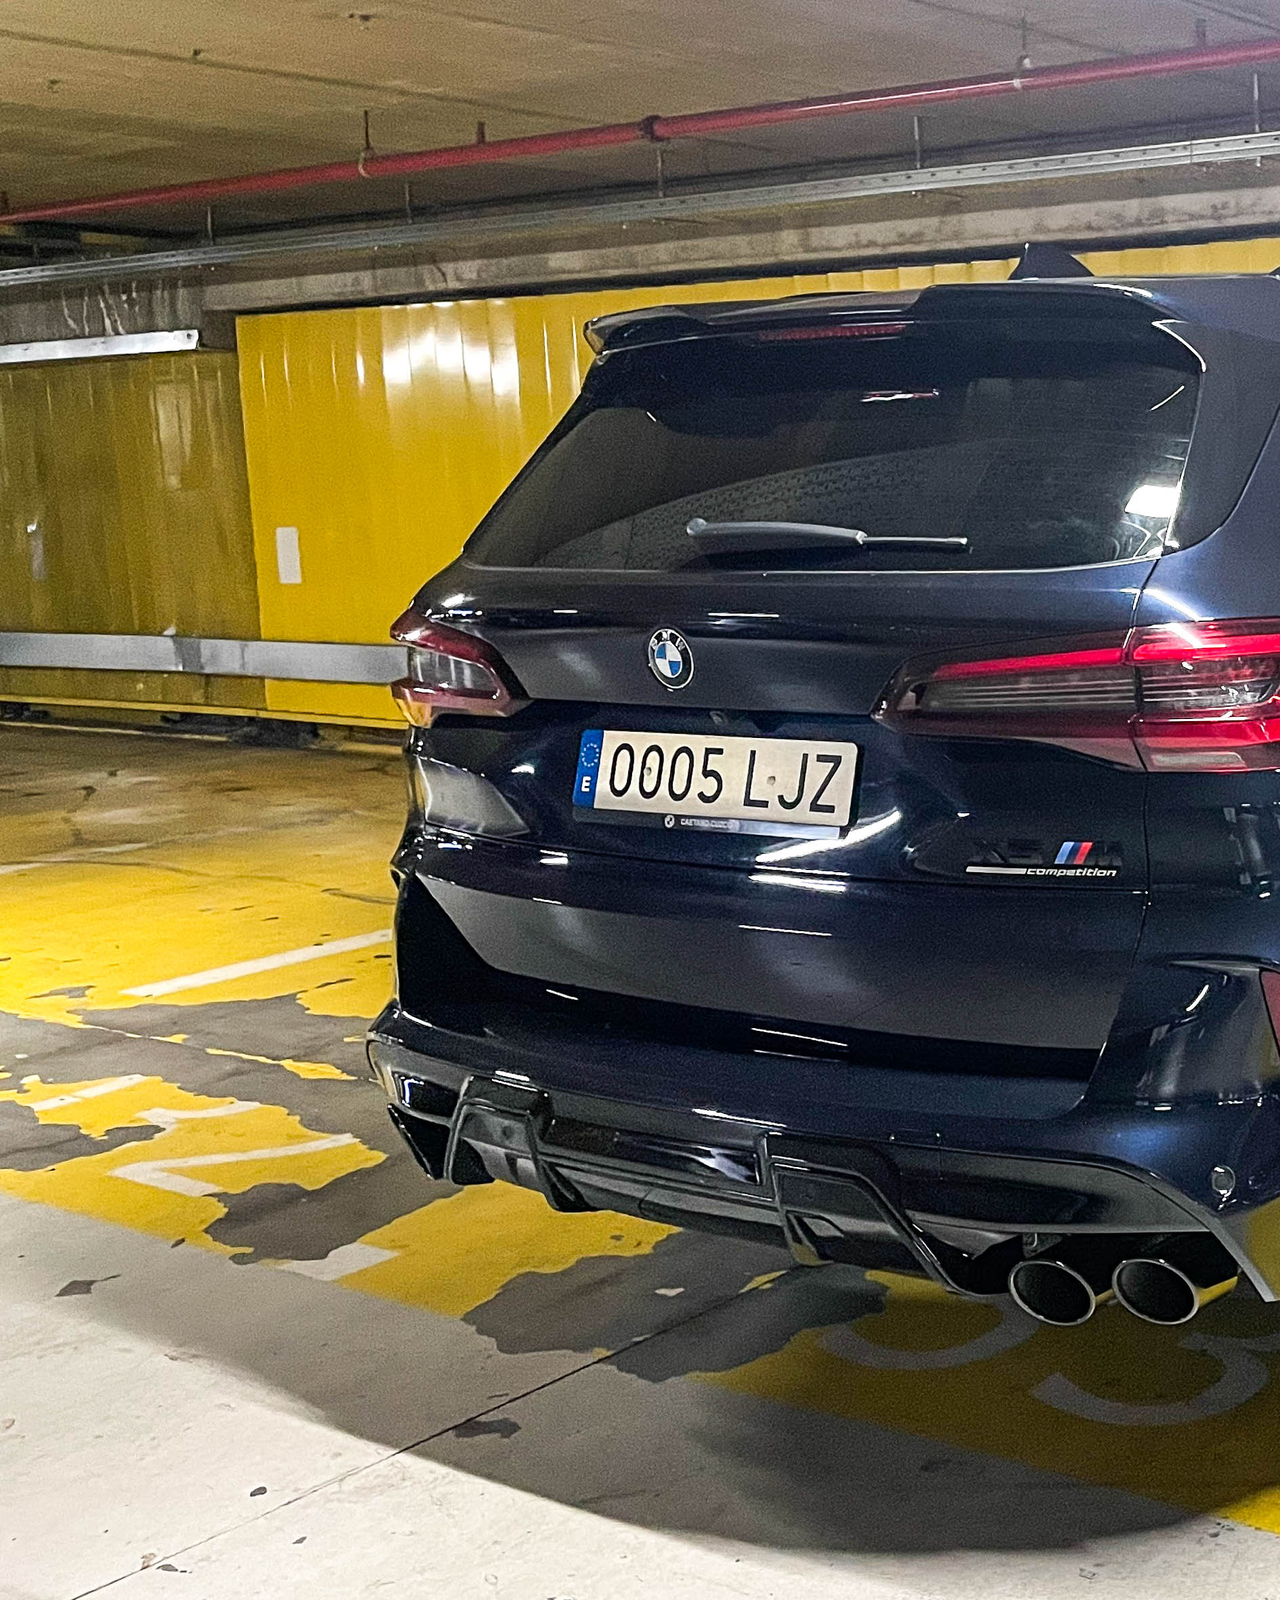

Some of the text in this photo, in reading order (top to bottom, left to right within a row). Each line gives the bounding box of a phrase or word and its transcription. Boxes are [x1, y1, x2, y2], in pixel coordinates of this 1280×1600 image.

[650, 630, 686, 652] BMW
[580, 776, 591, 792] E
[608, 742, 843, 814] 0005 LJZ
[1026, 867, 1118, 878] competition
